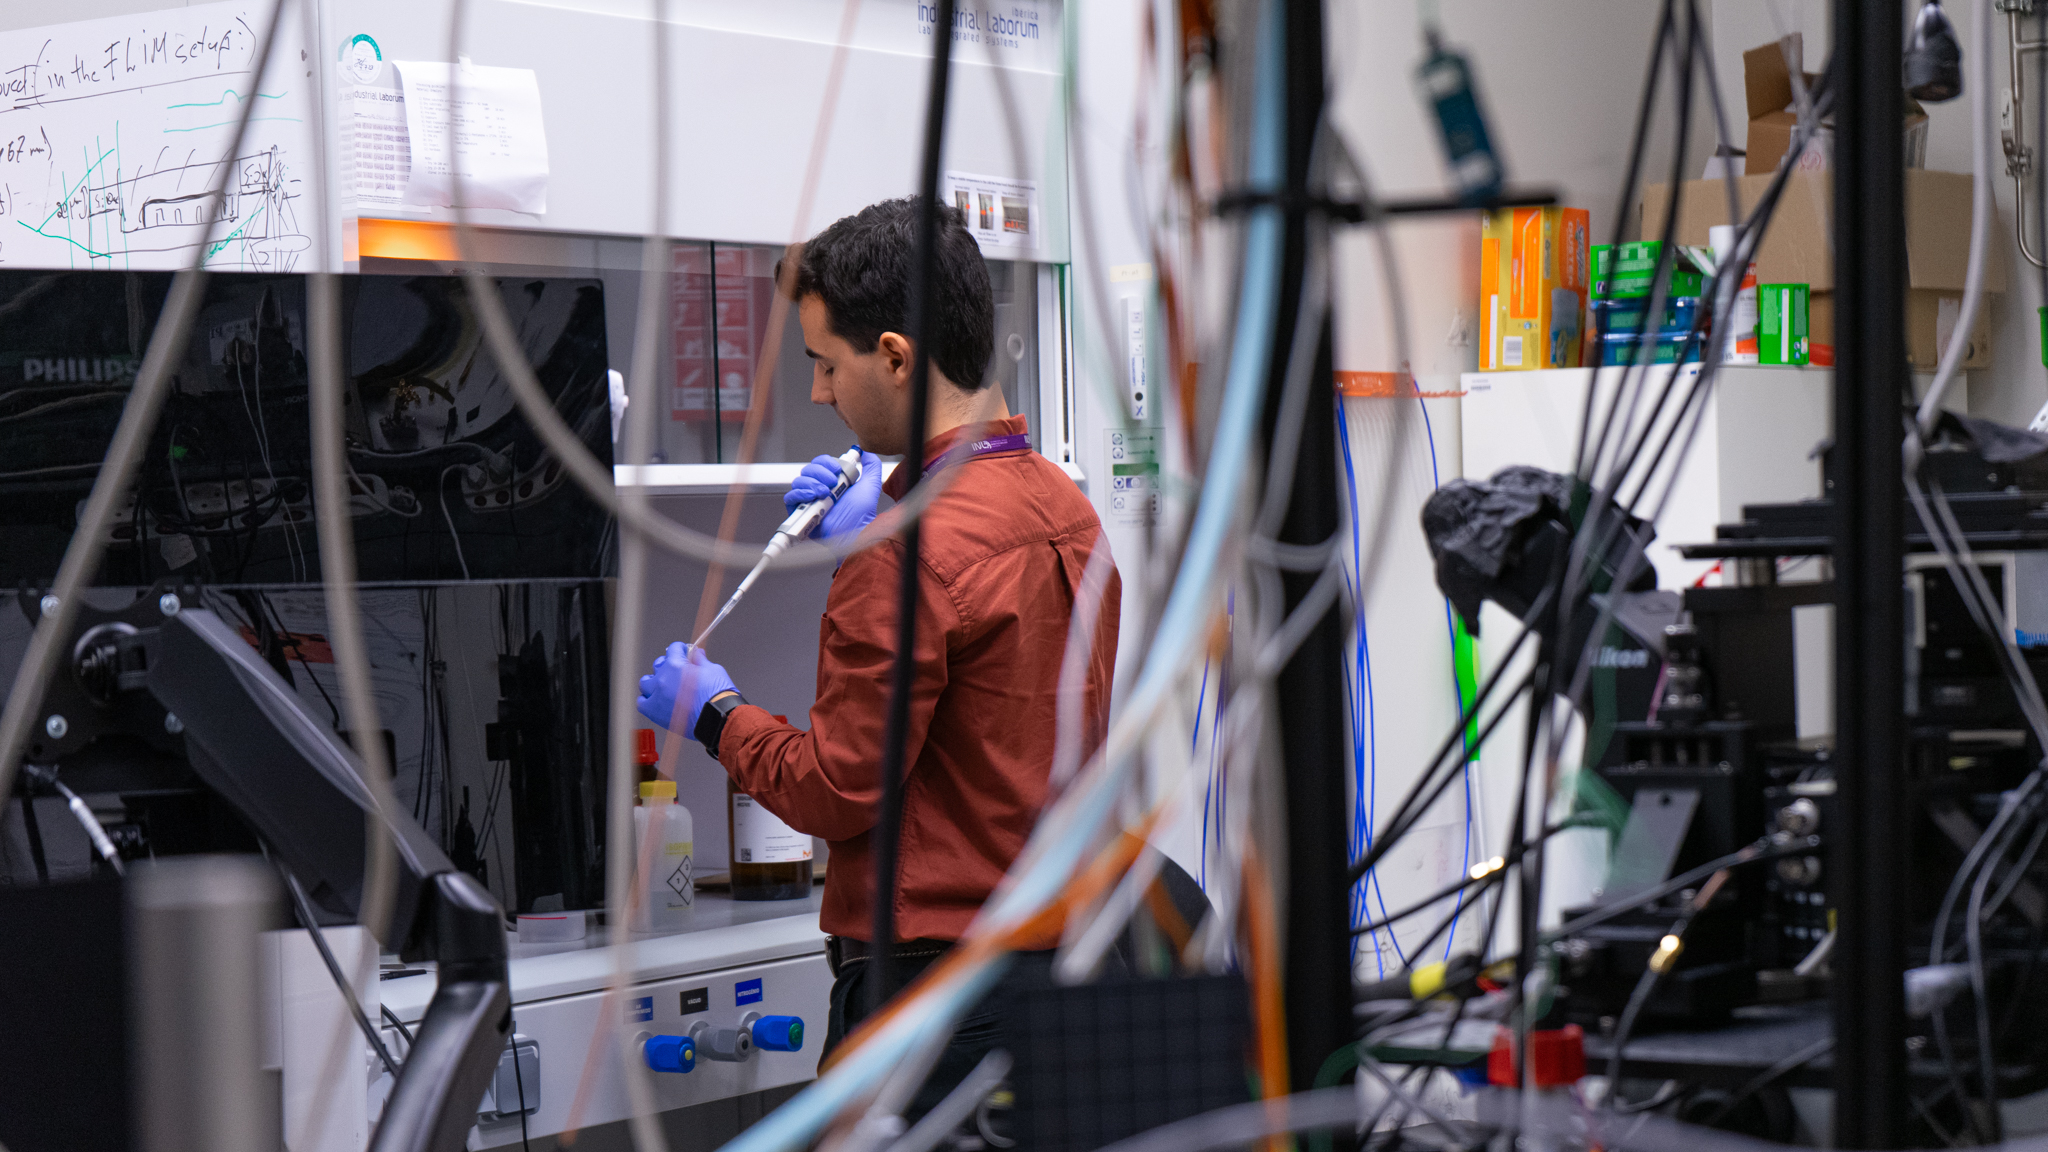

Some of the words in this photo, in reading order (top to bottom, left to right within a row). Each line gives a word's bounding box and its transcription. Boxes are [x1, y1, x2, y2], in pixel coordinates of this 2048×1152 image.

[918, 0, 981, 30] indstrial
[1012, 7, 1038, 20] iberica
[71, 53, 100, 84] the
[23, 357, 141, 382] PHILIPS
